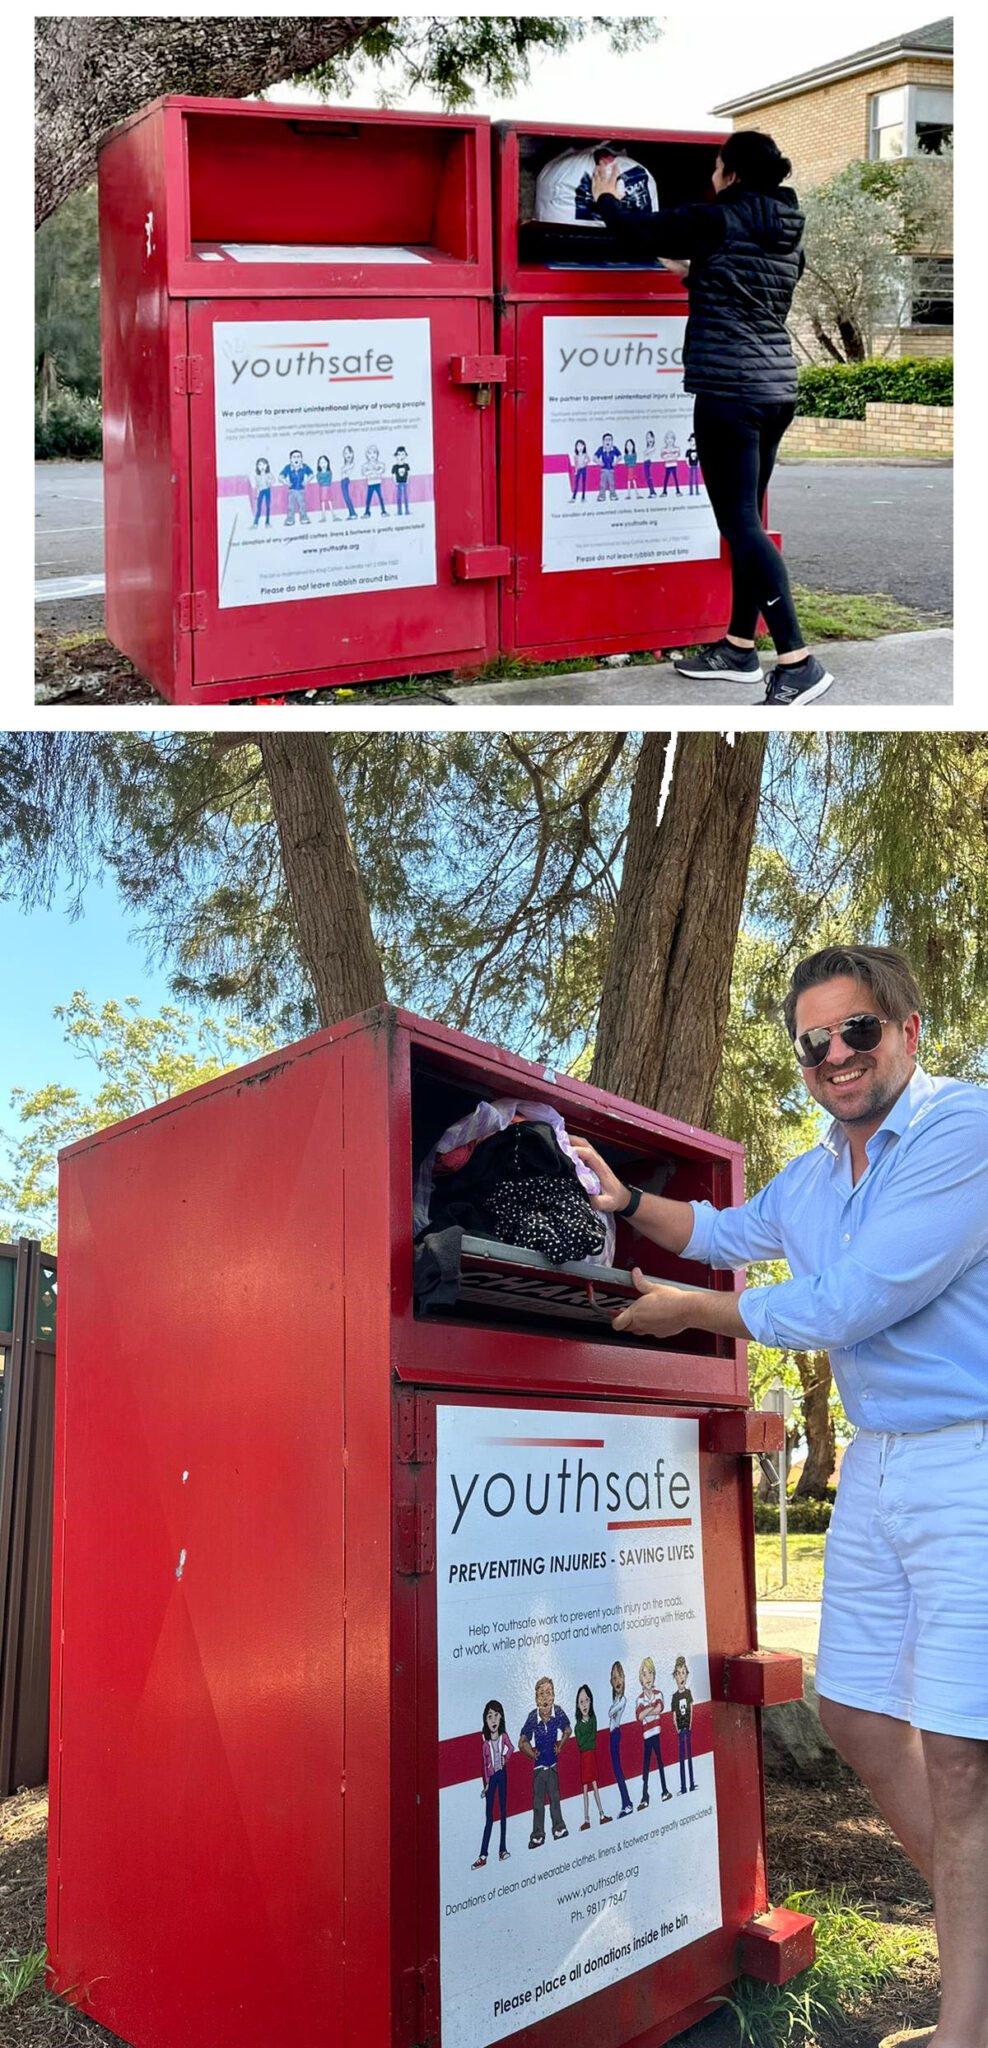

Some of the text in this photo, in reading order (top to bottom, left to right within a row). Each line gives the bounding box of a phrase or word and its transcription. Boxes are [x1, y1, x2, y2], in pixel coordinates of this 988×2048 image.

[232, 349, 394, 384] youthsafe
[560, 342, 684, 372] youthsa
[236, 408, 262, 418] partner
[274, 406, 302, 416] prevent
[304, 404, 349, 413] unintentional
[350, 402, 368, 412] injury
[371, 402, 378, 410] of
[380, 402, 400, 410] young
[402, 400, 426, 409] people
[576, 554, 595, 562] Please
[634, 550, 654, 558] rubbish
[260, 586, 284, 595] Please
[298, 583, 310, 591] not
[311, 582, 330, 590] leave
[332, 578, 358, 588] rubbish
[359, 576, 382, 584] around
[384, 574, 398, 582] bins
[459, 1272, 634, 1309] CHARI
[450, 1458, 690, 1534] youthsafe
[449, 1557, 545, 1583] PREVENTING
[550, 1552, 606, 1573] INJURIES
[619, 1547, 664, 1566] SAVING
[668, 1545, 694, 1560] LIVES
[453, 1646, 463, 1658] at
[466, 1640, 490, 1655] work,
[492, 1636, 516, 1651] while
[518, 1630, 550, 1649] playing
[551, 1628, 572, 1643] sport
[573, 1627, 590, 1638] and
[591, 1622, 612, 1635] when
[614, 1620, 626, 1632] out
[627, 1614, 660, 1630] socialising
[661, 1611, 674, 1623] with
[469, 1624, 490, 1638] Help
[493, 1617, 537, 1635] Youthsafe
[538, 1614, 558, 1626] work
[560, 1612, 568, 1622] to
[570, 1609, 600, 1624] prevent
[602, 1605, 622, 1618] youth
[624, 1602, 640, 1616] injury
[643, 1602, 652, 1611] on
[653, 1598, 663, 1608] the
[446, 1806, 712, 1916] Donations of clean and wearable clothes, linens & footwear are greatly appreciated!
[557, 1865, 640, 1905] www.youthsafe.org
[571, 1890, 628, 1923] Ph. 9817 7847
[494, 1914, 688, 2017] Please place all donations inside the bin
